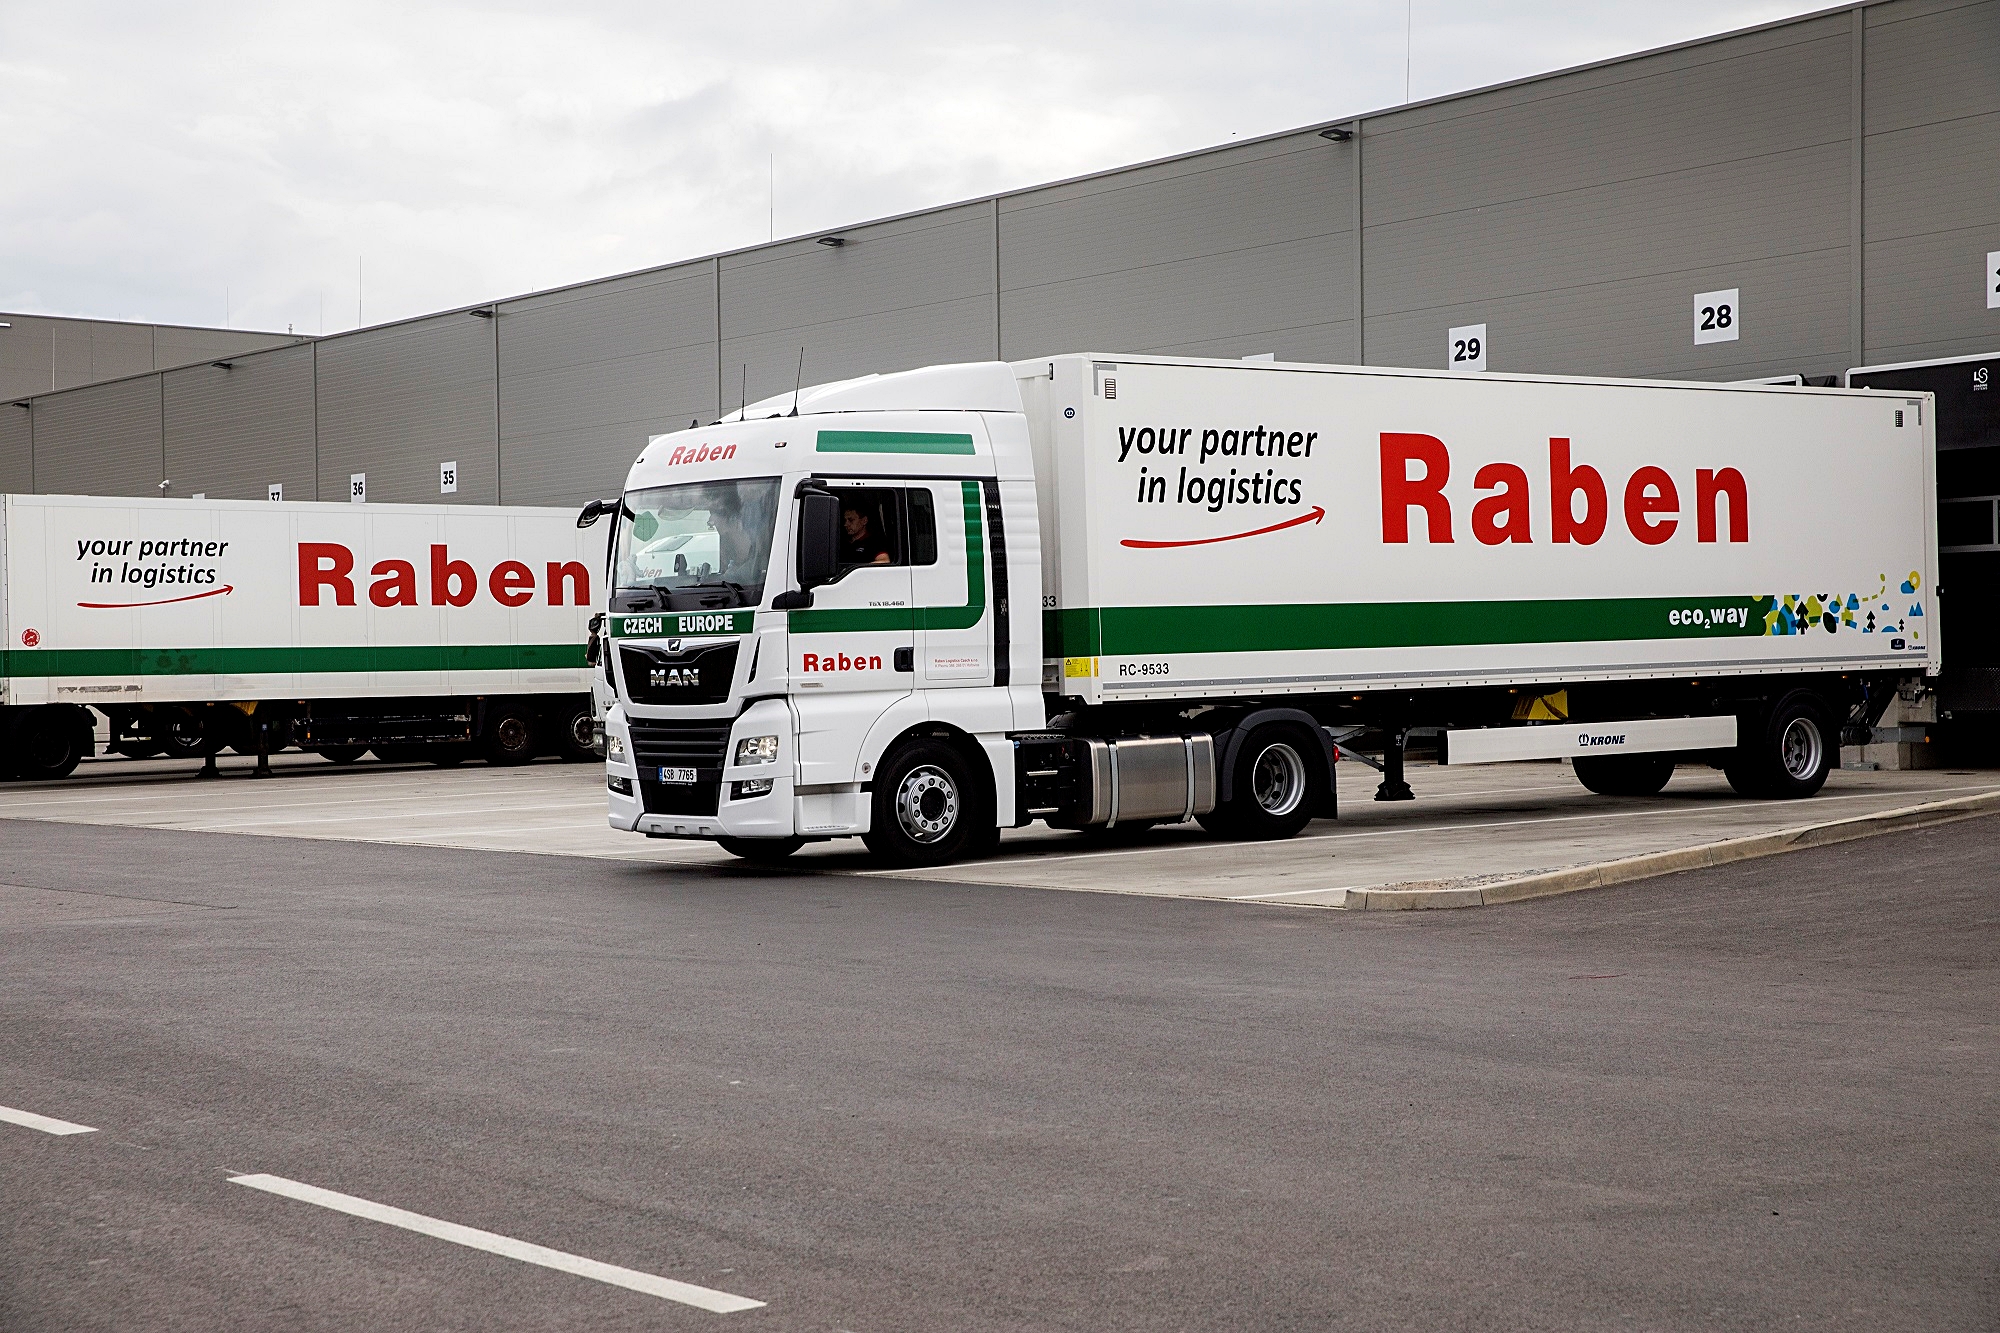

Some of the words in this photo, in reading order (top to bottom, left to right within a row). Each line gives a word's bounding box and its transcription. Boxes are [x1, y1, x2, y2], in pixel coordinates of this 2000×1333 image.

[1699, 304, 1732, 330] 28
[1453, 337, 1481, 362] 29
[668, 443, 737, 466] Raben
[1117, 425, 1193, 463] your
[1199, 425, 1318, 465] partner
[352, 482, 364, 496] 36
[442, 470, 455, 485] 35
[1137, 466, 1166, 504] in
[1177, 467, 1303, 513] logistics
[1379, 432, 1749, 547] Raben
[76, 538, 133, 561] your
[138, 539, 229, 561] partner
[90, 562, 113, 585] in
[120, 562, 217, 588] logistics
[297, 542, 591, 608] Raben
[623, 617, 663, 634] CZECH
[678, 614, 734, 632] EUROPE
[803, 652, 882, 673] Raben
[1119, 662, 1170, 677] RC-9533
[650, 669, 700, 687] MAN
[1590, 734, 1626, 746] KRONE
[663, 768, 675, 781] 4SB
[678, 768, 694, 781] 7765
